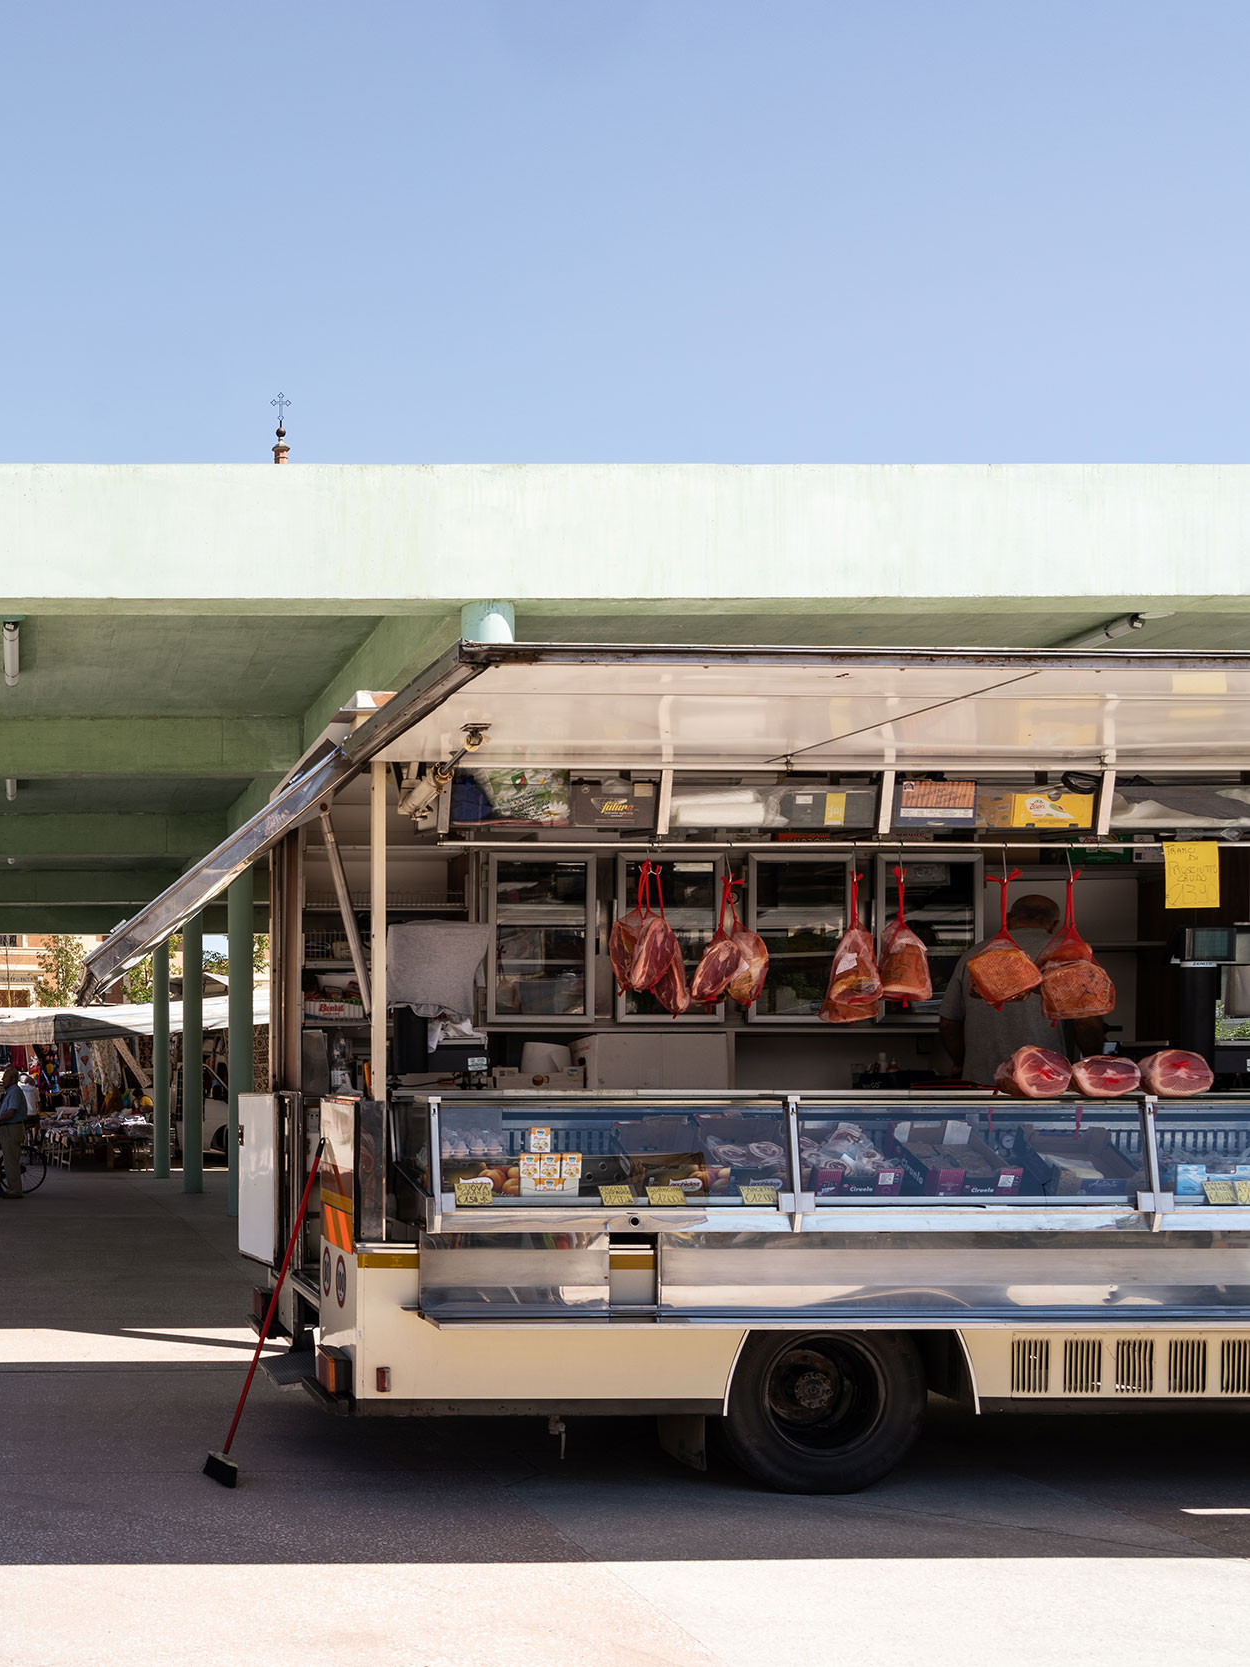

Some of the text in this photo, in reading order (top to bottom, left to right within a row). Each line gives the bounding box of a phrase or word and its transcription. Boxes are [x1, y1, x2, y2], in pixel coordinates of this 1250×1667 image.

[600, 801, 635, 815] futura
[1165, 844, 1196, 856] TRANCI
[1167, 861, 1218, 877] PROSCIUTTO
[1177, 874, 1207, 882] CRUDO
[849, 1185, 873, 1193] Ciruelo
